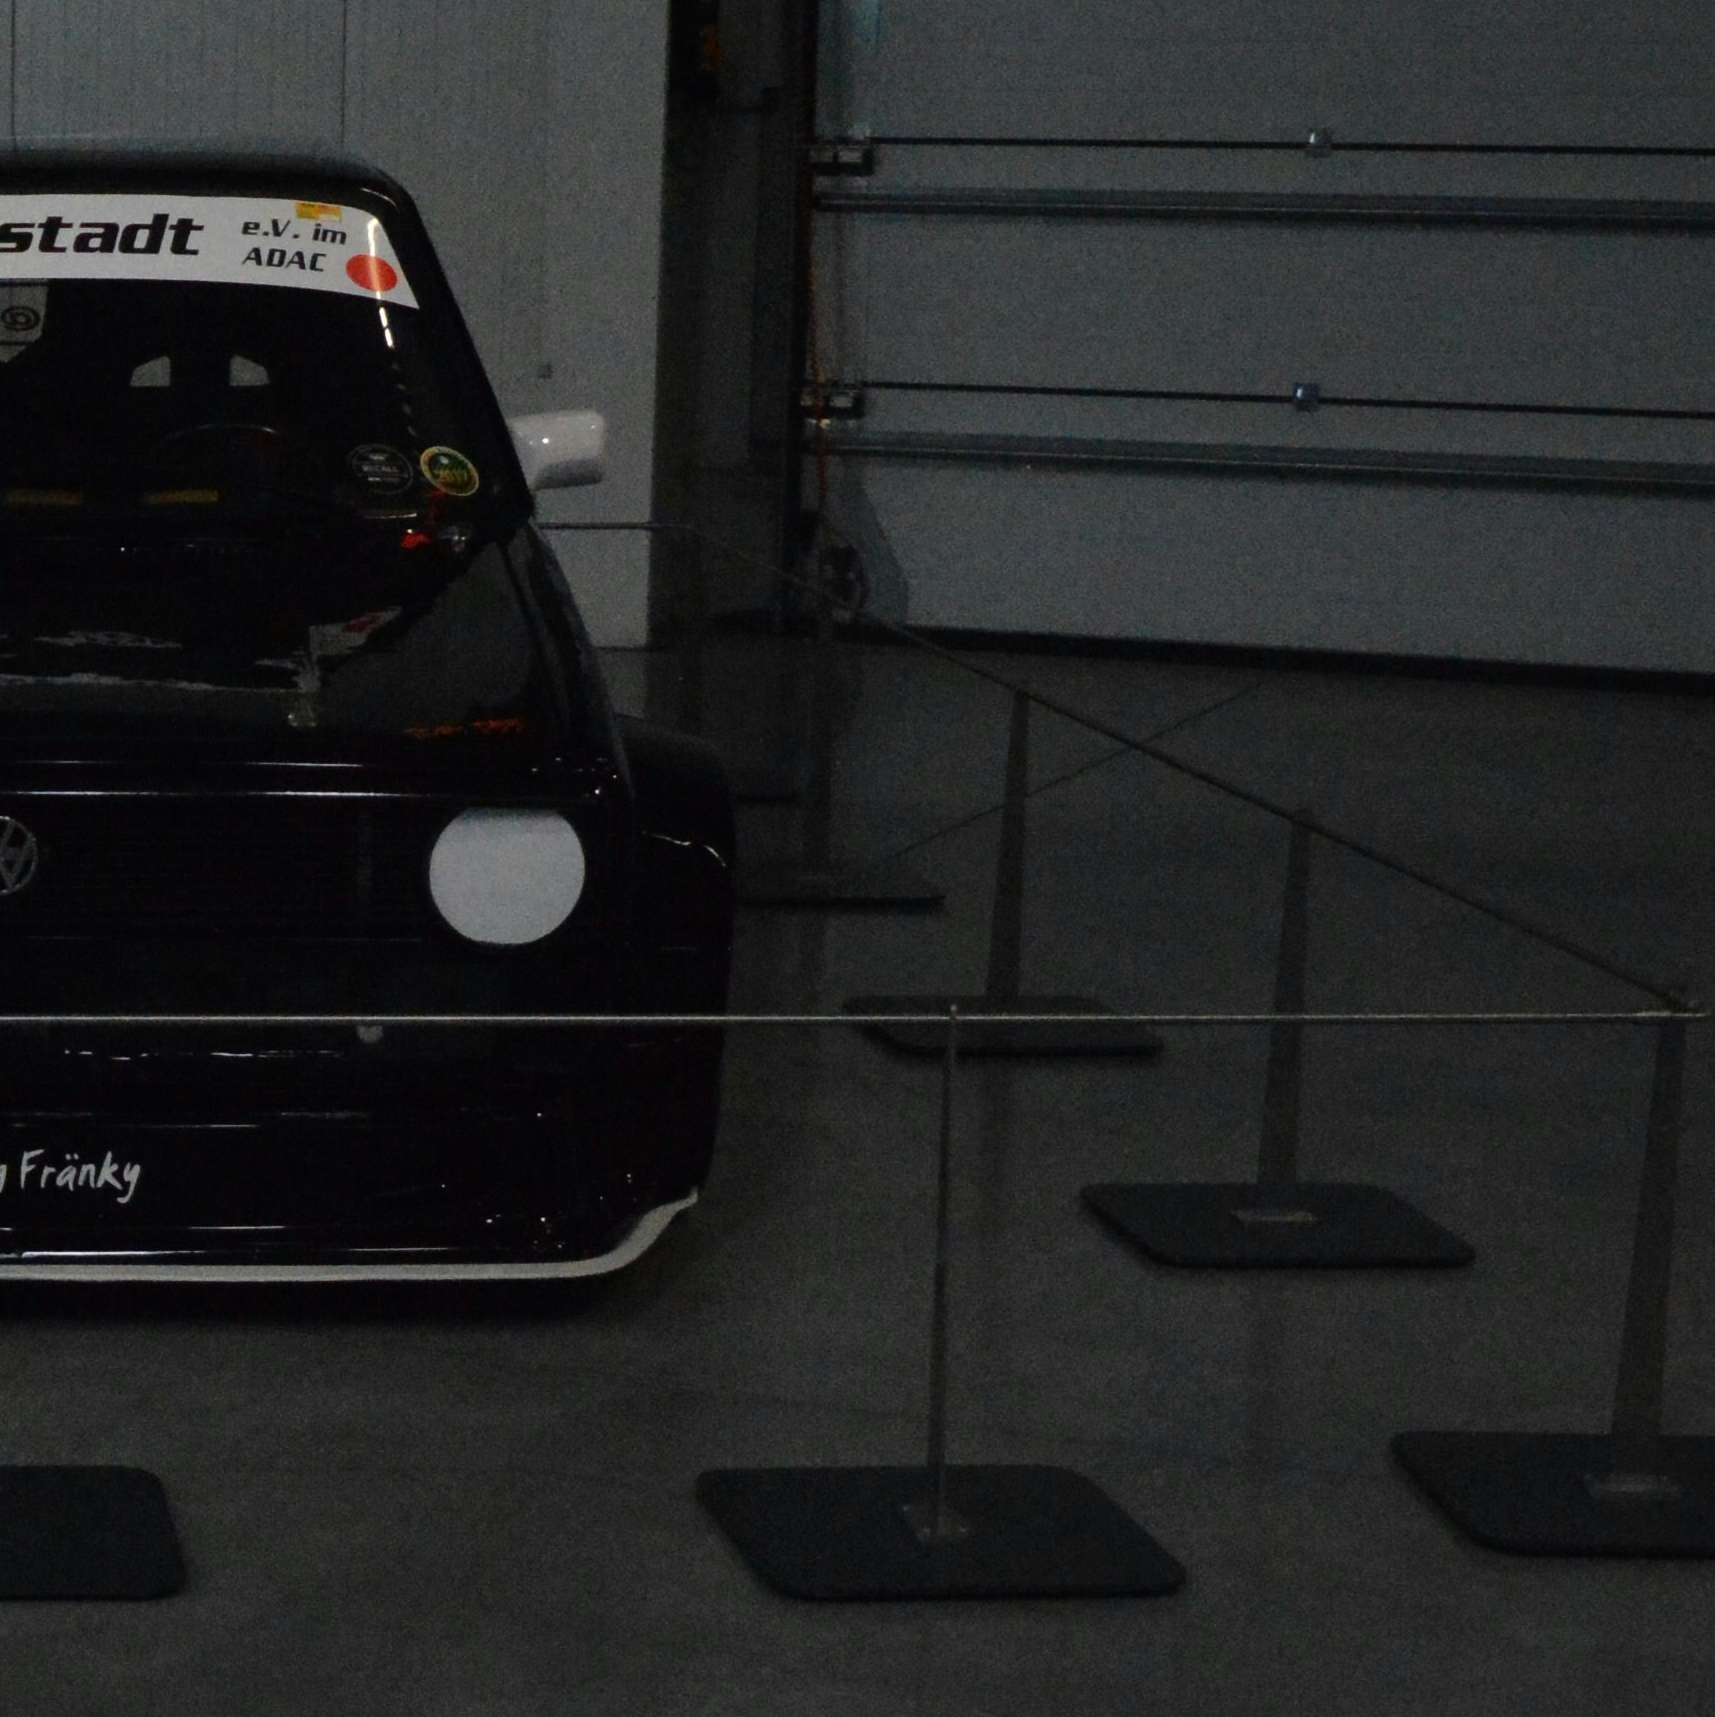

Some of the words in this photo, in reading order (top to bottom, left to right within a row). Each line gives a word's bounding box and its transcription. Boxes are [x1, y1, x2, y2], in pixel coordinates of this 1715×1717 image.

[241, 219, 301, 239] e.V.
[312, 223, 348, 245] im
[241, 247, 327, 272] ADAC
[19, 1148, 141, 1204] Fränky
